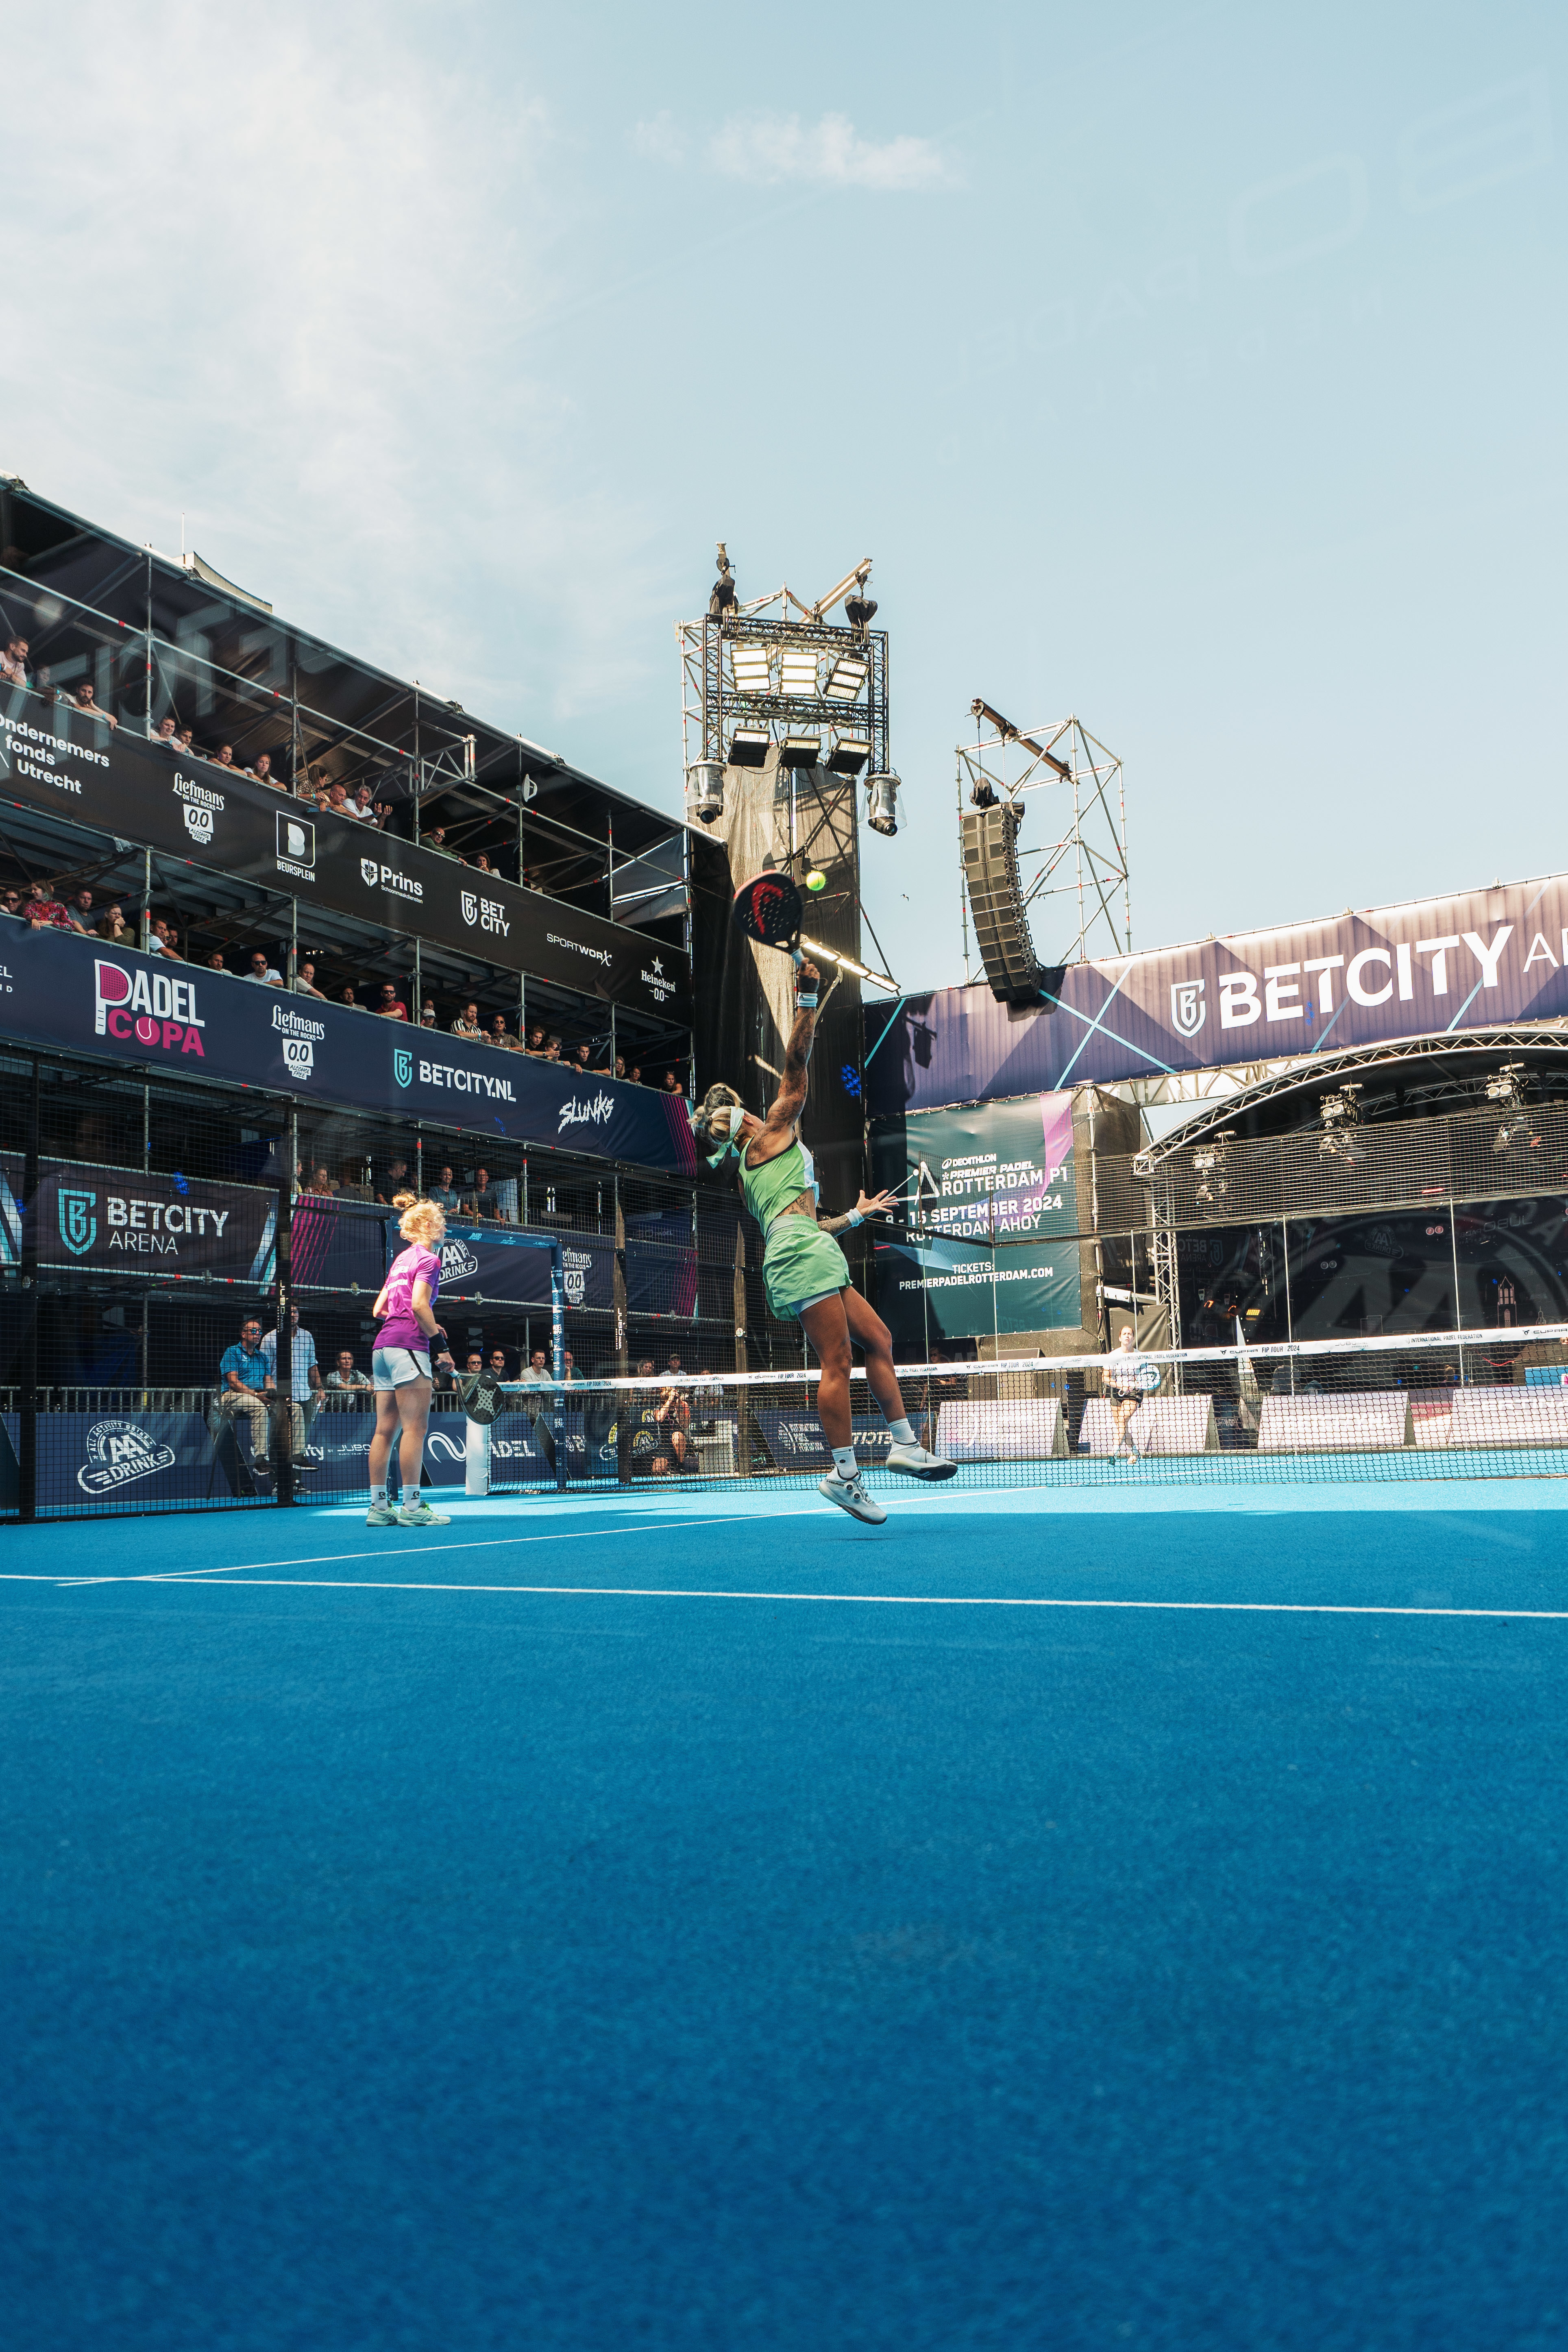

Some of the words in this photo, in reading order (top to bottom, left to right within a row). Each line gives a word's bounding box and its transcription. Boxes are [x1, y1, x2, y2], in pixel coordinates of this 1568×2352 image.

[6, 735, 55, 765] fonds
[17, 759, 81, 794] Utrecht
[172, 773, 224, 811] Liefmans
[190, 796, 200, 804] THE
[200, 799, 216, 810] ROCKS
[189, 809, 209, 828] 0.0
[190, 828, 210, 839] ALCOHOL
[277, 860, 315, 882] BEURSPLEIN
[381, 865, 423, 896] Prins
[381, 885, 423, 904] Schoonmaakdiensten
[480, 897, 505, 919] BET
[481, 914, 510, 937] CITY
[1219, 925, 1514, 1030] BETCITY
[1523, 928, 1568, 973] A
[94, 959, 205, 1035] PADEL
[108, 1008, 205, 1057] COPA
[271, 1005, 324, 1040] Liefmans
[301, 1032, 316, 1041] ROCKS
[288, 1043, 309, 1062] 0.0
[290, 1065, 309, 1074] ALCOHOL
[419, 1060, 516, 1102] BETCITY.NL
[950, 1165, 997, 1180] PREMIER
[1000, 1161, 1034, 1173] PADEL
[953, 1153, 996, 1167] DECATHLON
[942, 1170, 1043, 1196] ROTTERDAM
[1050, 1167, 1068, 1184] P1
[107, 1197, 229, 1237] BETCITY
[931, 1199, 1018, 1223] SEPTEMBER
[1023, 1195, 1063, 1212] 2024
[1000, 1214, 1041, 1233] AHOY
[109, 1230, 179, 1255] ARENA
[439, 1262, 468, 1281] DRINK
[899, 1267, 1053, 1290] PREMIERPADELROTTERDAM.COM
[952, 1262, 995, 1274] TICKETS:
[567, 1274, 581, 1289] 0.0
[92, 1422, 122, 1437] ACTIVITY
[126, 1424, 149, 1440] DRINK
[108, 1434, 148, 1464] AA
[488, 1440, 536, 1458] ADEL
[107, 1453, 161, 1481] DRINK
